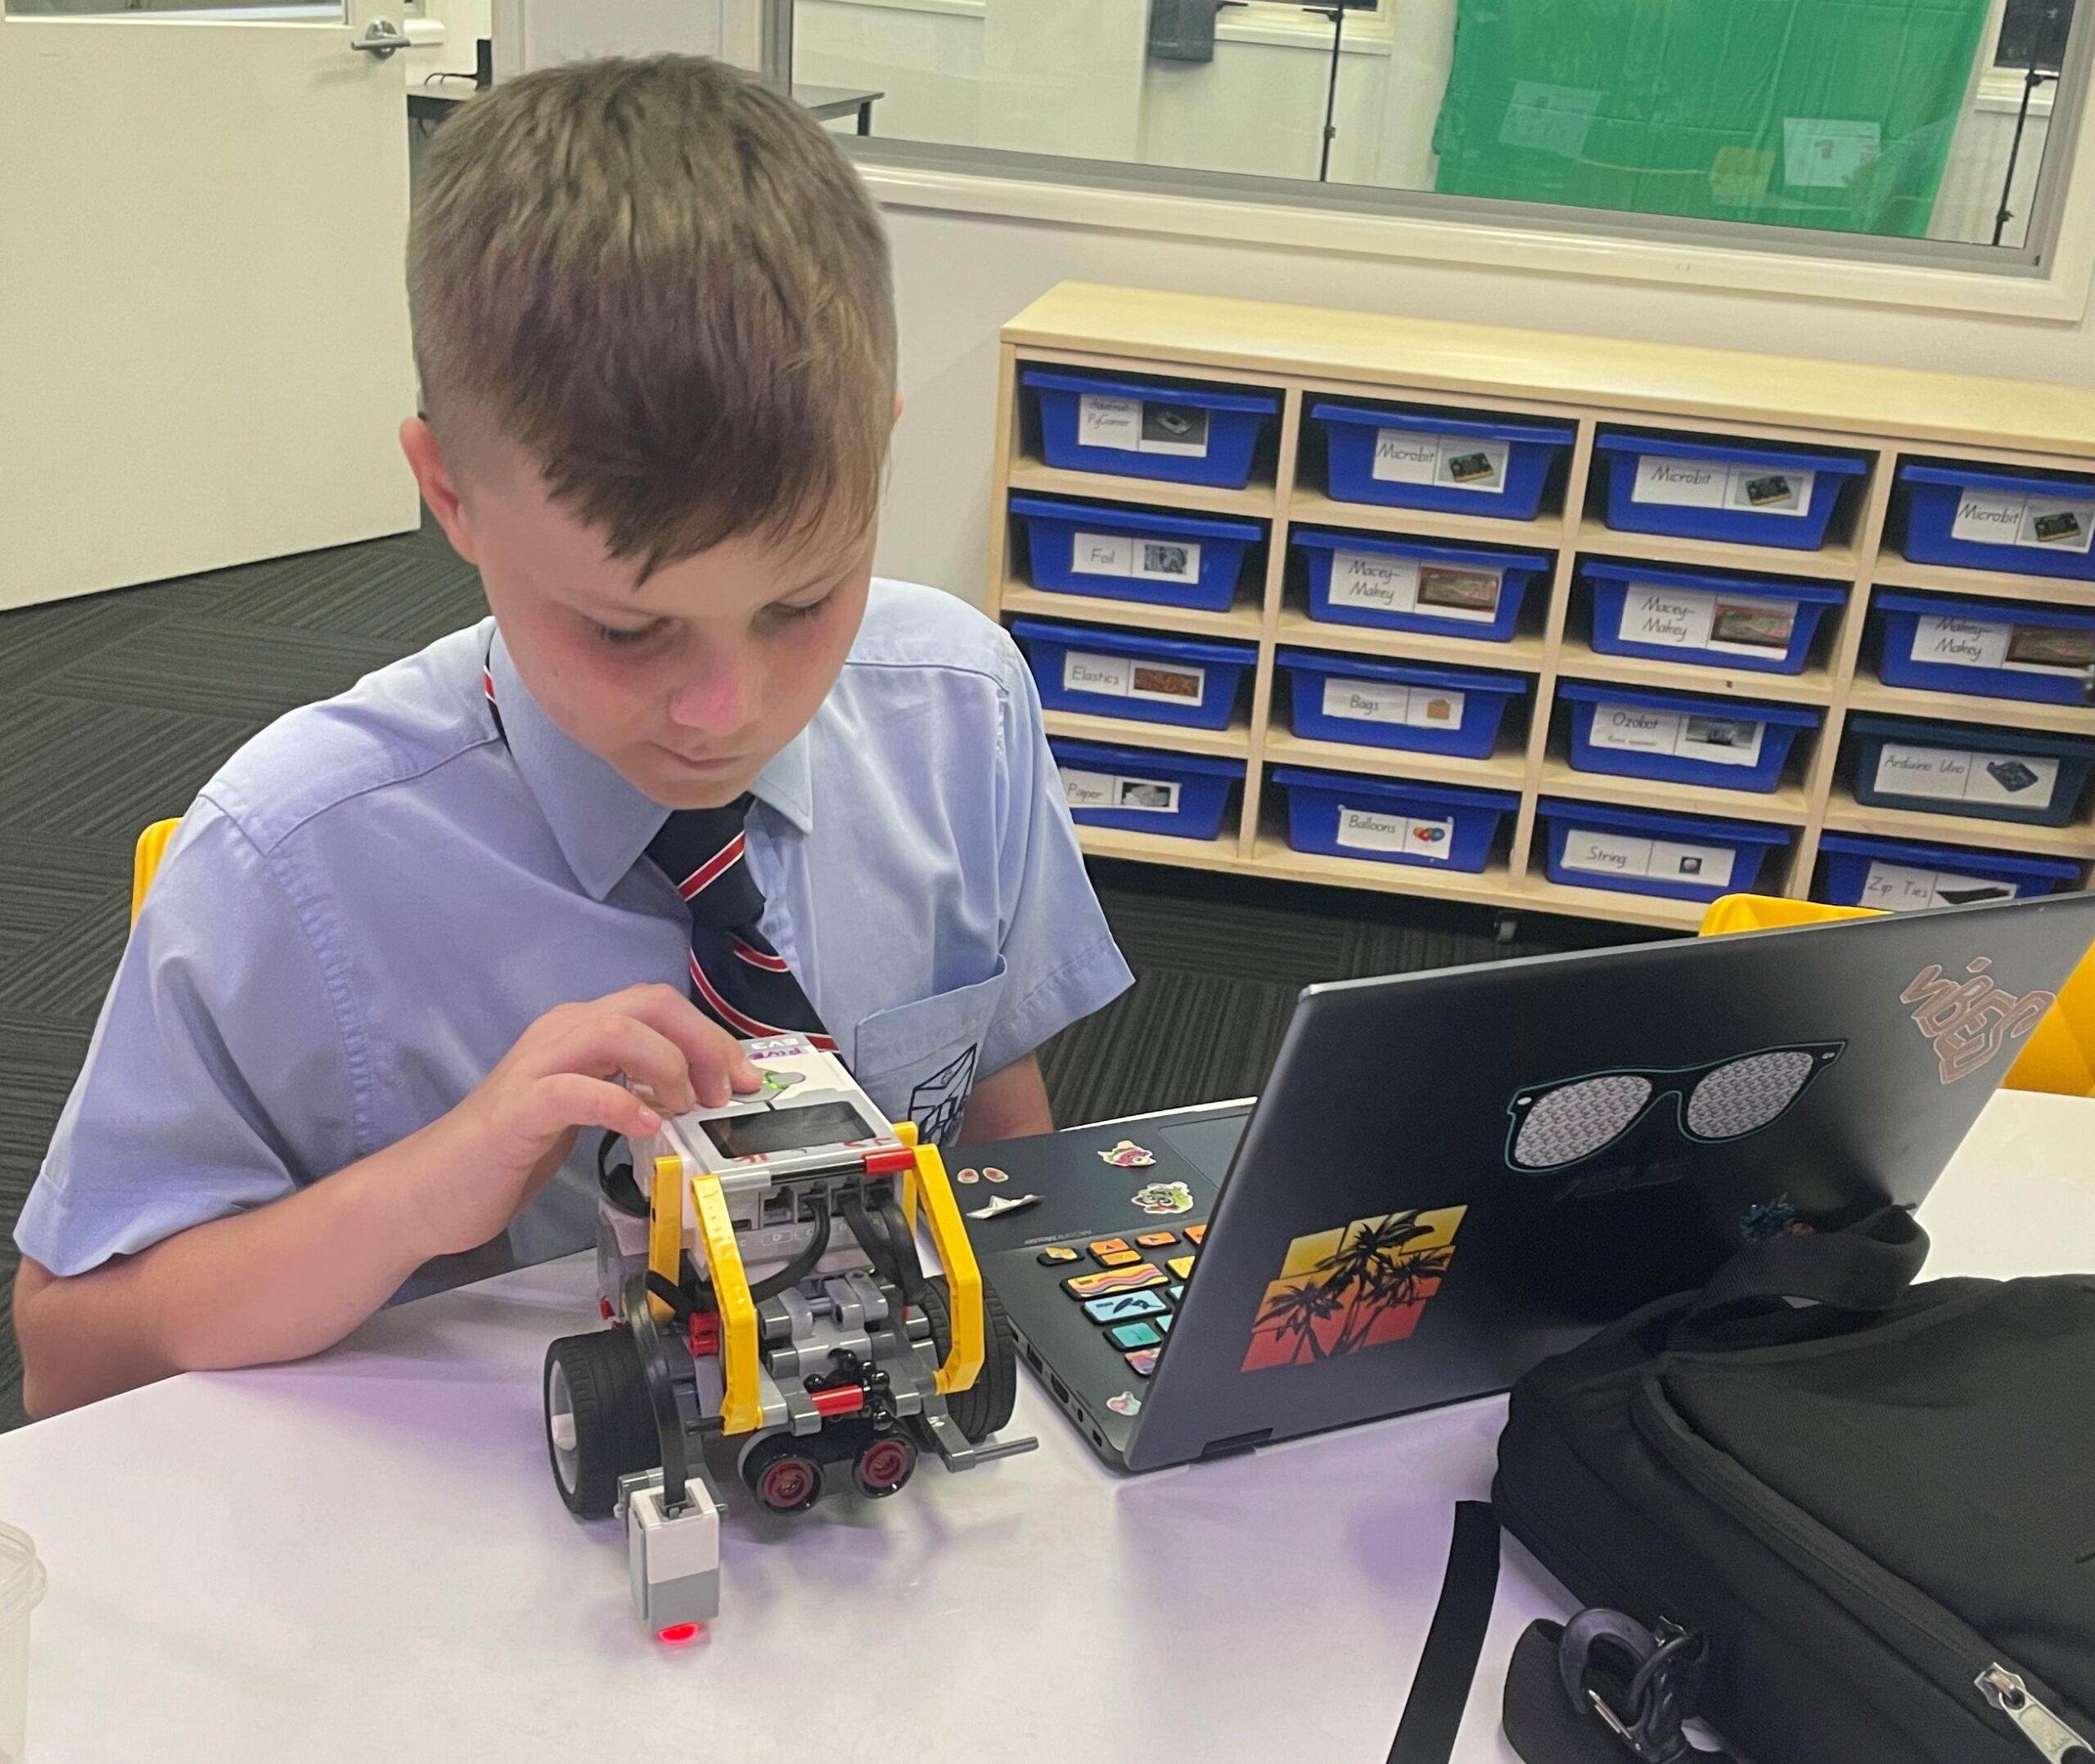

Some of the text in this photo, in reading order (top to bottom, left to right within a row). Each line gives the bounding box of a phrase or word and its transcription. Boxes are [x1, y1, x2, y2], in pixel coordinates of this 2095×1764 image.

[1376, 442, 1435, 463] Microbit
[1650, 465, 1712, 486] Microbit
[1957, 502, 2021, 524] Microbit
[1090, 547, 1116, 564] Foil
[1349, 581, 1394, 605] Makey
[1641, 617, 1687, 642] Makey
[1934, 637, 1983, 661] Makey
[1071, 665, 1120, 686] Elastics
[1349, 695, 1379, 716] Bags
[1612, 712, 1660, 730] Ozobot
[1884, 754, 1965, 774] Arduino Uno
[1067, 782, 1103, 803] Paper
[1349, 814, 1396, 835] Balloons
[1586, 846, 1628, 869] String
[1867, 875, 1894, 896] Zip
[750, 1037, 800, 1051] EV3
